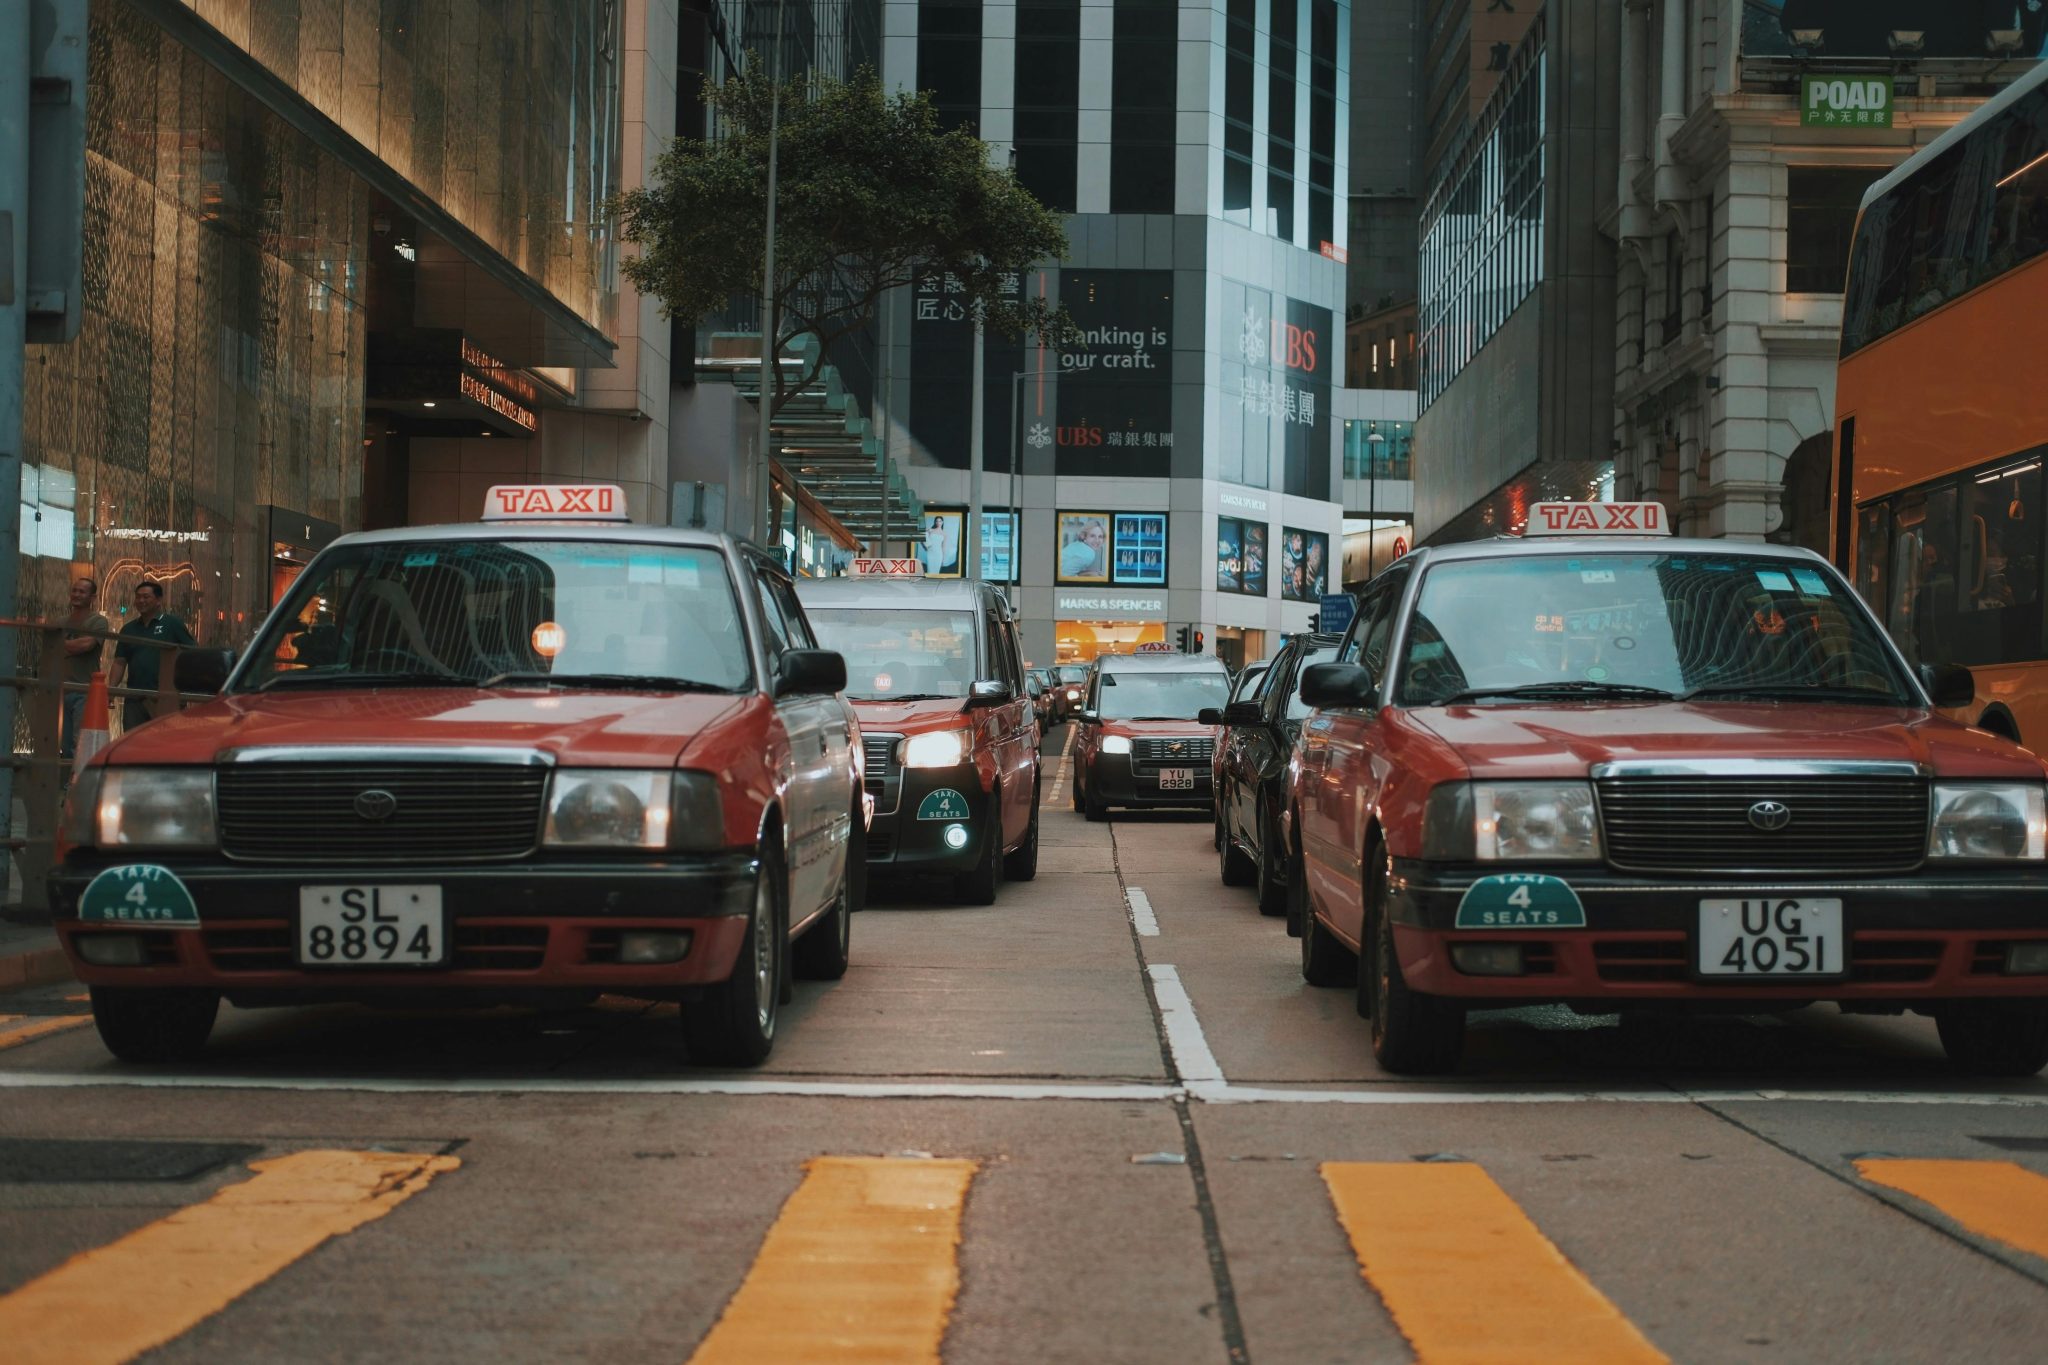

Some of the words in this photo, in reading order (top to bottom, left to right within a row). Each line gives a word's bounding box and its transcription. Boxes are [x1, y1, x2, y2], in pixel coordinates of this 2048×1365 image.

[1809, 81, 1886, 110] POAD
[1151, 327, 1167, 345] is
[1271, 319, 1317, 372] UBS
[1061, 353, 1097, 368] our
[1102, 349, 1156, 369] craft.
[1239, 375, 1315, 428] 瑞銀集團
[1057, 426, 1103, 446] UBS
[1107, 431, 1174, 447] 瑞銀集團
[496, 488, 613, 513] TAXI
[1539, 504, 1658, 529] TAXI
[855, 559, 916, 573] TAXI
[1060, 598, 1099, 609] MARKS
[1109, 600, 1162, 611] SPENCER
[1140, 643, 1172, 651] TAXI
[876, 677, 891, 687] TAXI
[1169, 769, 1185, 778] YU
[1161, 779, 1192, 788] 2928
[933, 790, 956, 799] TAXI
[939, 798, 950, 810] 4
[928, 810, 961, 818] SEATS
[112, 866, 162, 881] TAXI
[125, 881, 147, 906] 4
[1507, 884, 1533, 909] 4
[103, 907, 174, 919] SEATS
[341, 888, 399, 923] SL
[1483, 911, 1559, 924] SEATS
[1741, 900, 1802, 936] UG
[309, 924, 432, 960] 8894
[1720, 935, 1824, 973] 4051
